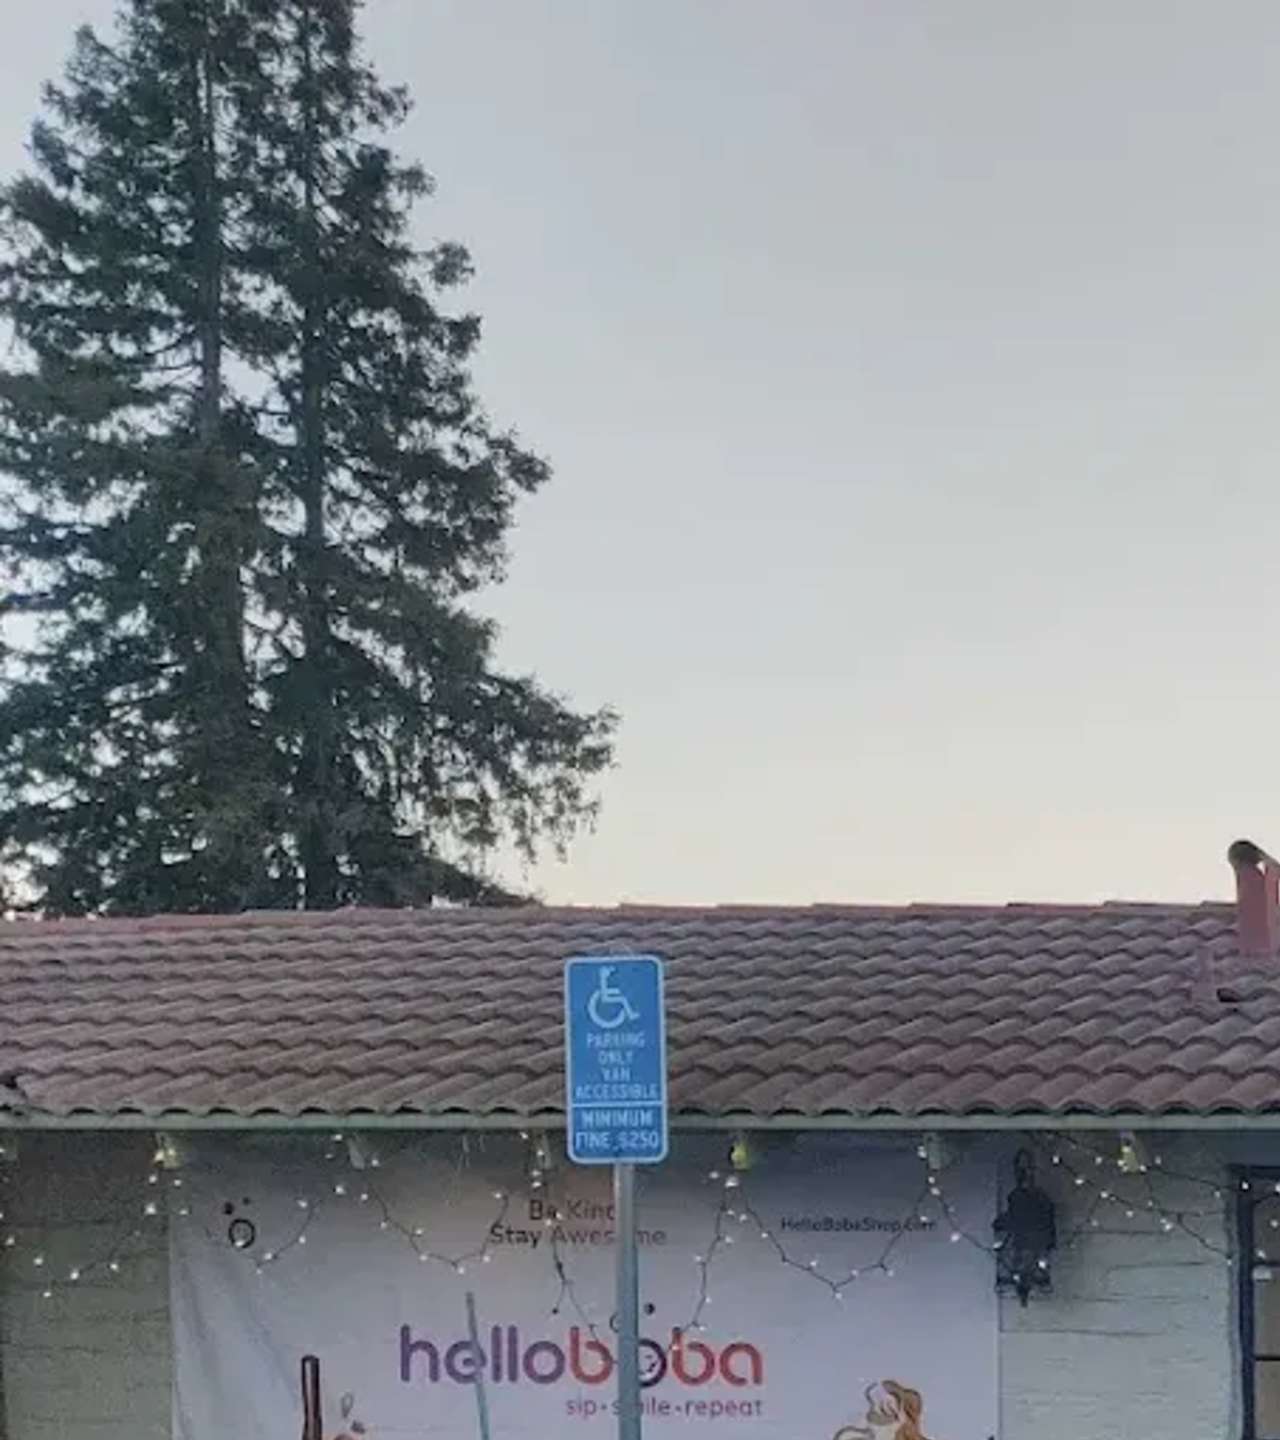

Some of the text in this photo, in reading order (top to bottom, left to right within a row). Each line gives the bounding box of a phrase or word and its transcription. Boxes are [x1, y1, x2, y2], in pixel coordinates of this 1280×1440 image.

[586, 1033, 646, 1049] PARKING
[597, 1050, 634, 1066] ONLY
[602, 1067, 631, 1083] VAN
[575, 1083, 659, 1100] ACCESSIBLE
[580, 1109, 654, 1130] MINIMUM
[575, 1130, 659, 1150] FINE $250
[489, 1224, 667, 1248] Stay Awesme
[400, 1324, 763, 1388] helloboba
